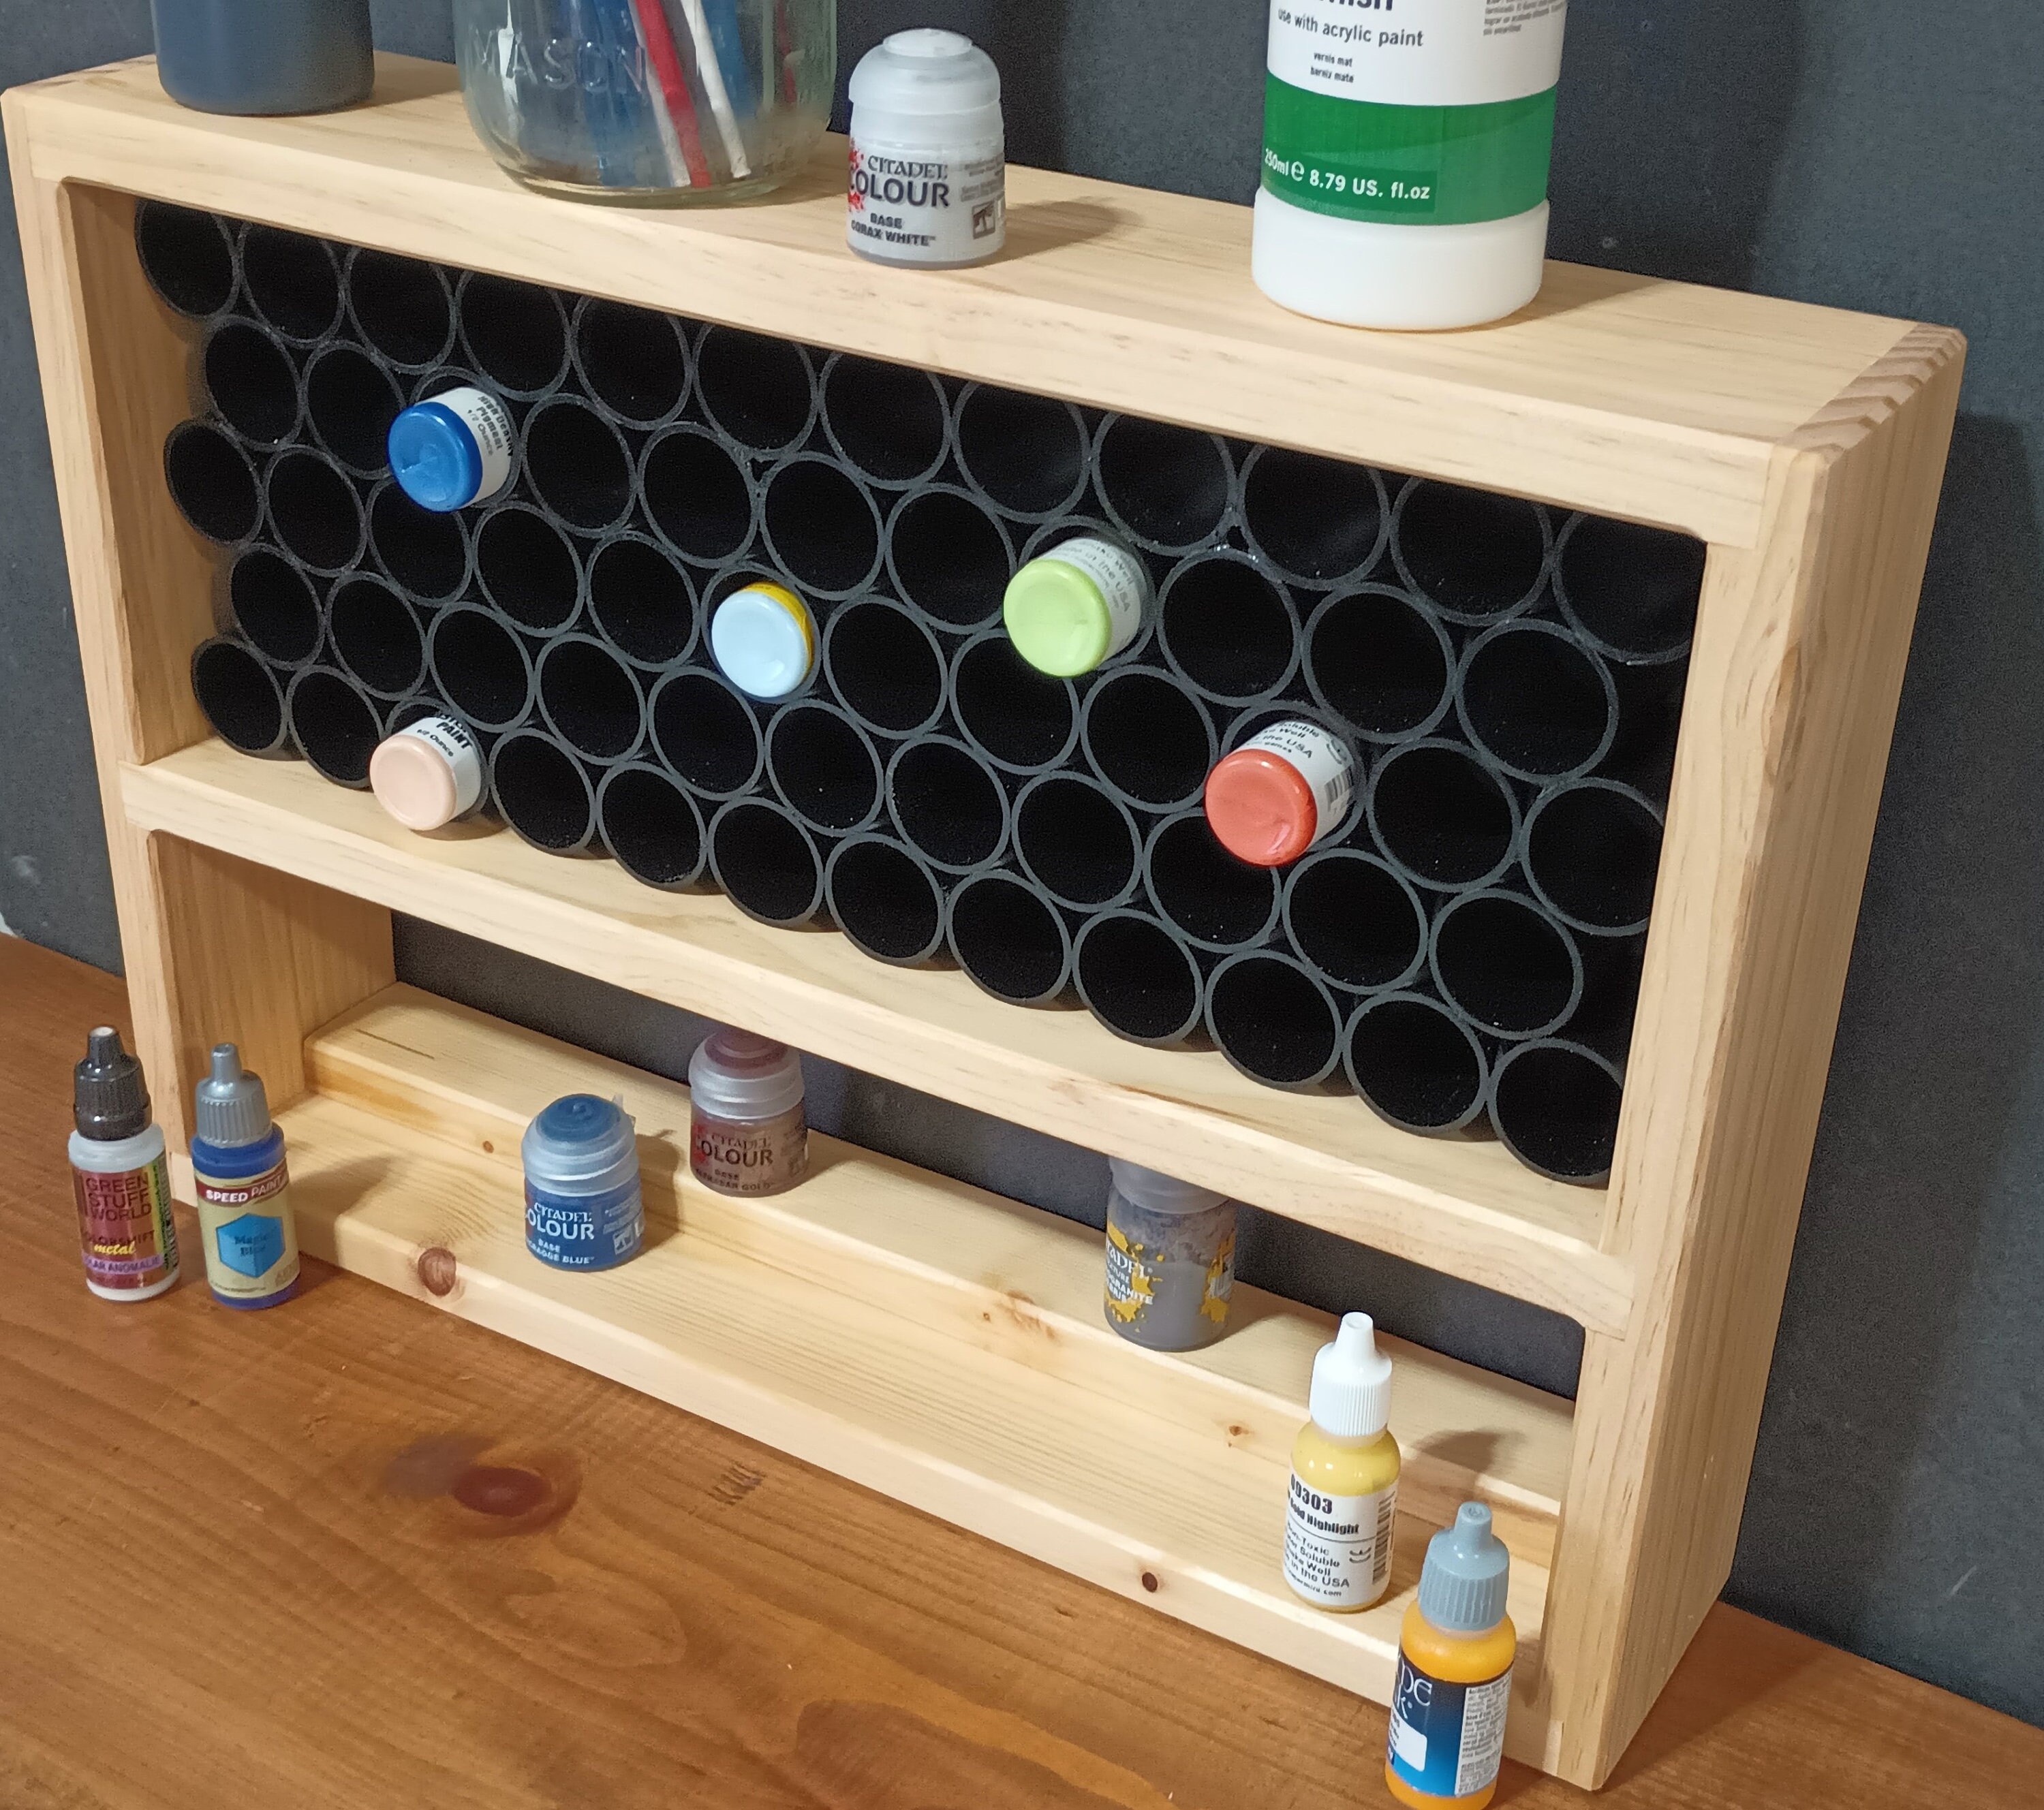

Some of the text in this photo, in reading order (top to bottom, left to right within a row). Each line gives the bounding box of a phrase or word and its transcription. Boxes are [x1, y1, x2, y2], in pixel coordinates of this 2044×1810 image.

[1278, 8, 1424, 47] use with acrylic paint
[1314, 52, 1353, 67] vernis mat
[1334, 72, 1354, 83] mate
[867, 155, 948, 179] CITADEL
[852, 170, 950, 207] OLOUR
[1310, 169, 1346, 191] 8.79
[1352, 177, 1383, 198] US.
[1391, 181, 1430, 200] fl.oz
[870, 213, 903, 230] BASE
[436, 721, 473, 749] PAINT
[1286, 739, 1313, 758] USA
[697, 1140, 774, 1168] OLOUR
[86, 1171, 149, 1193] GREEN
[206, 1175, 284, 1203] SPEED PAINT
[89, 1191, 151, 1208] STUFF
[90, 1203, 152, 1221] WORLD
[534, 1202, 592, 1222] CITADEL
[526, 1208, 595, 1240] OLOUR
[94, 1241, 136, 1255] metal
[538, 1238, 560, 1253] BASE
[562, 1255, 591, 1264] BLUE
[1307, 1513, 1359, 1535] Highlight
[1300, 1546, 1340, 1567] Soluble
[1307, 1561, 1331, 1577] Well
[1322, 1576, 1350, 1588] USA
